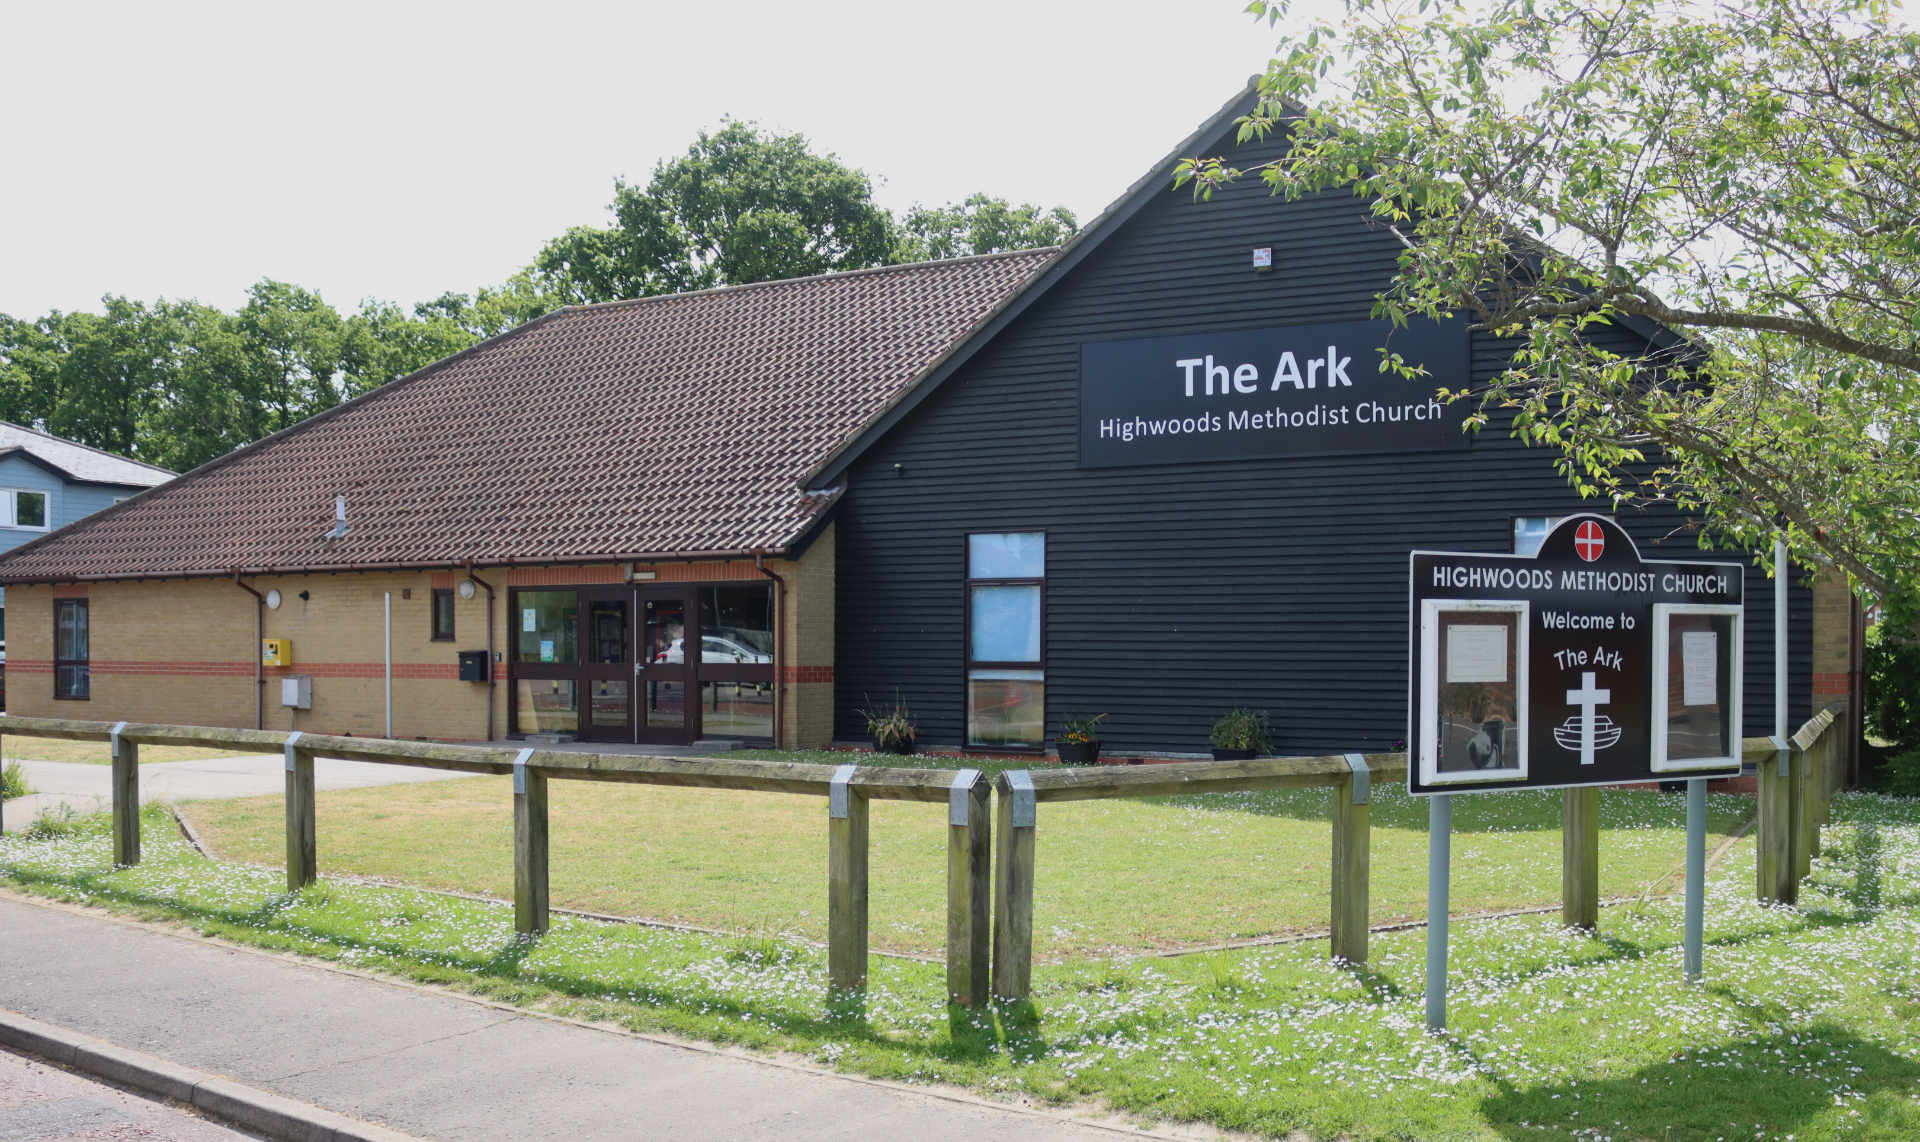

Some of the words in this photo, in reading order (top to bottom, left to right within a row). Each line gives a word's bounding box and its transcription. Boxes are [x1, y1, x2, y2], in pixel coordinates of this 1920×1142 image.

[1176, 355, 1259, 397] The
[1270, 346, 1353, 391] Ark
[1100, 411, 1222, 441] Highwoods
[1228, 404, 1349, 431] Methodist
[1356, 399, 1442, 424] Church
[1433, 566, 1553, 590] HIGHWOODS
[1561, 571, 1655, 592] METHODIST
[1663, 574, 1728, 594] CHURCH
[1542, 611, 1615, 630] Welcome
[1620, 612, 1635, 630] to
[1554, 648, 1588, 671] The
[1593, 646, 1623, 672] Ark
